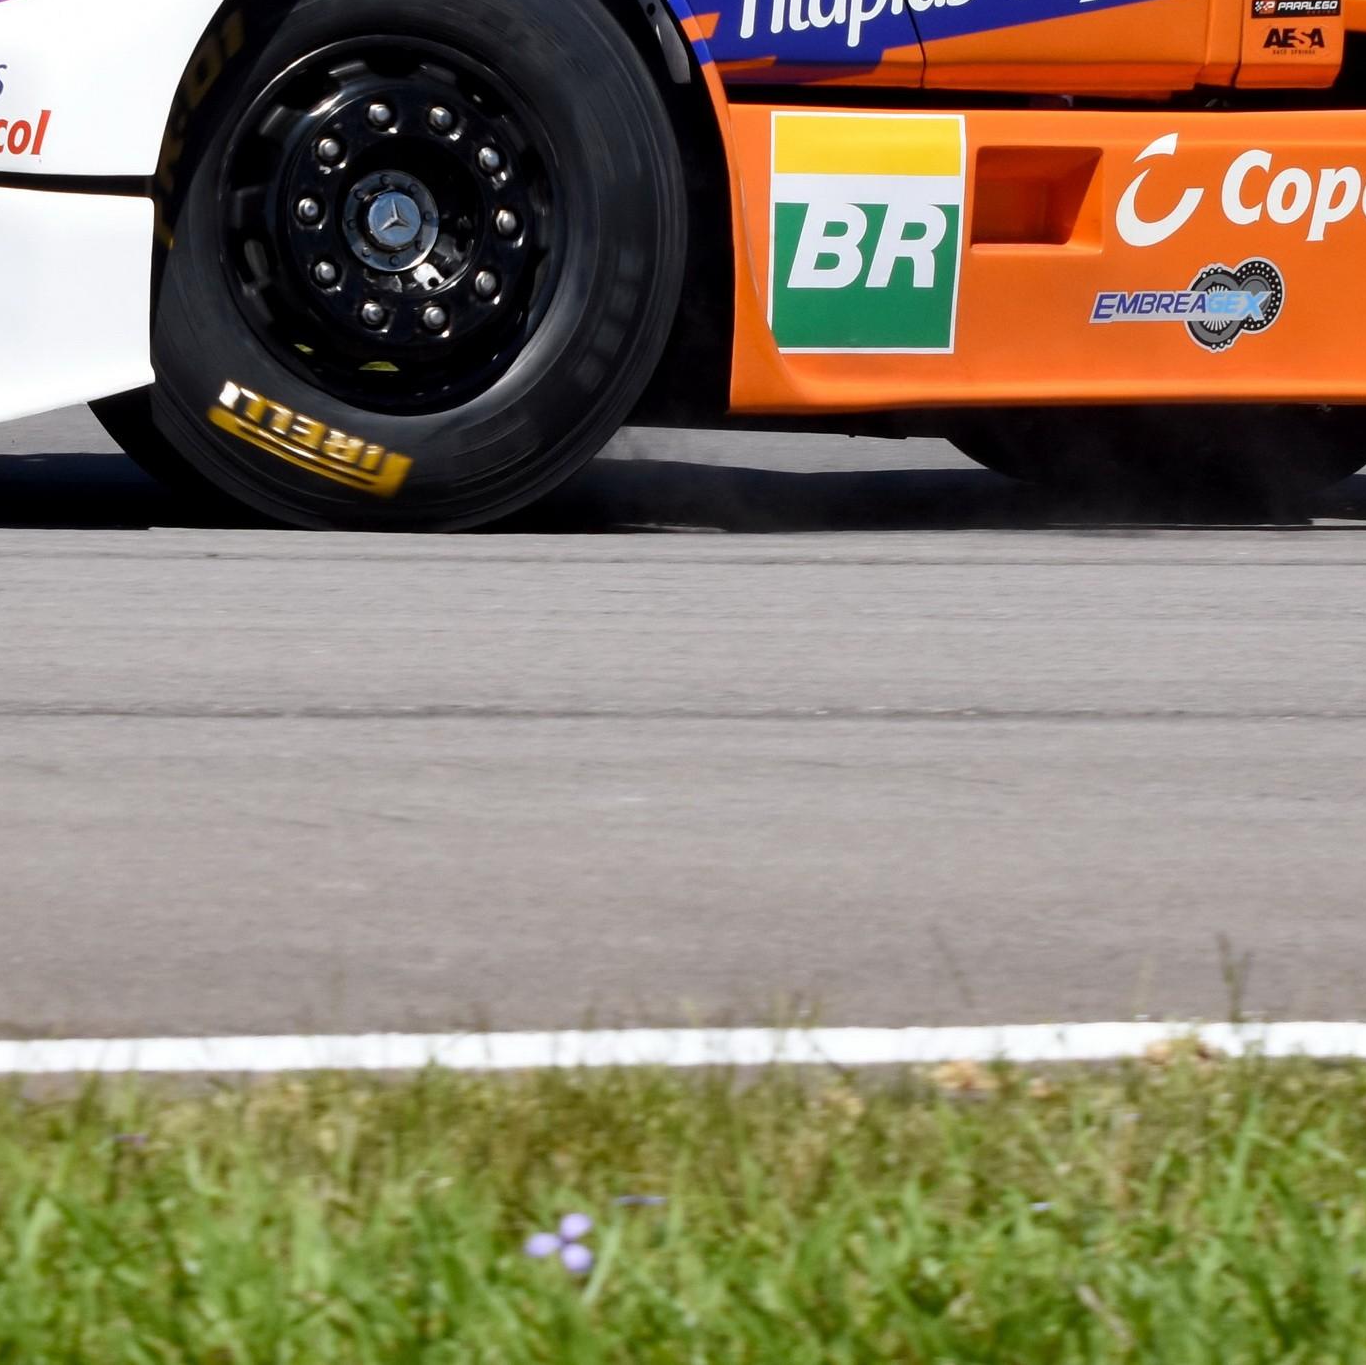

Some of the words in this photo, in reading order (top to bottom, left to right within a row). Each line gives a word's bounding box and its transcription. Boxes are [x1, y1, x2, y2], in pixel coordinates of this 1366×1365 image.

[1277, 0, 1339, 11] PARALEGO
[1263, 28, 1325, 48] AESA
[787, 198, 948, 289] BR
[1093, 292, 1269, 320] EMBREAGEX
[208, 380, 413, 499] PIRELLI
